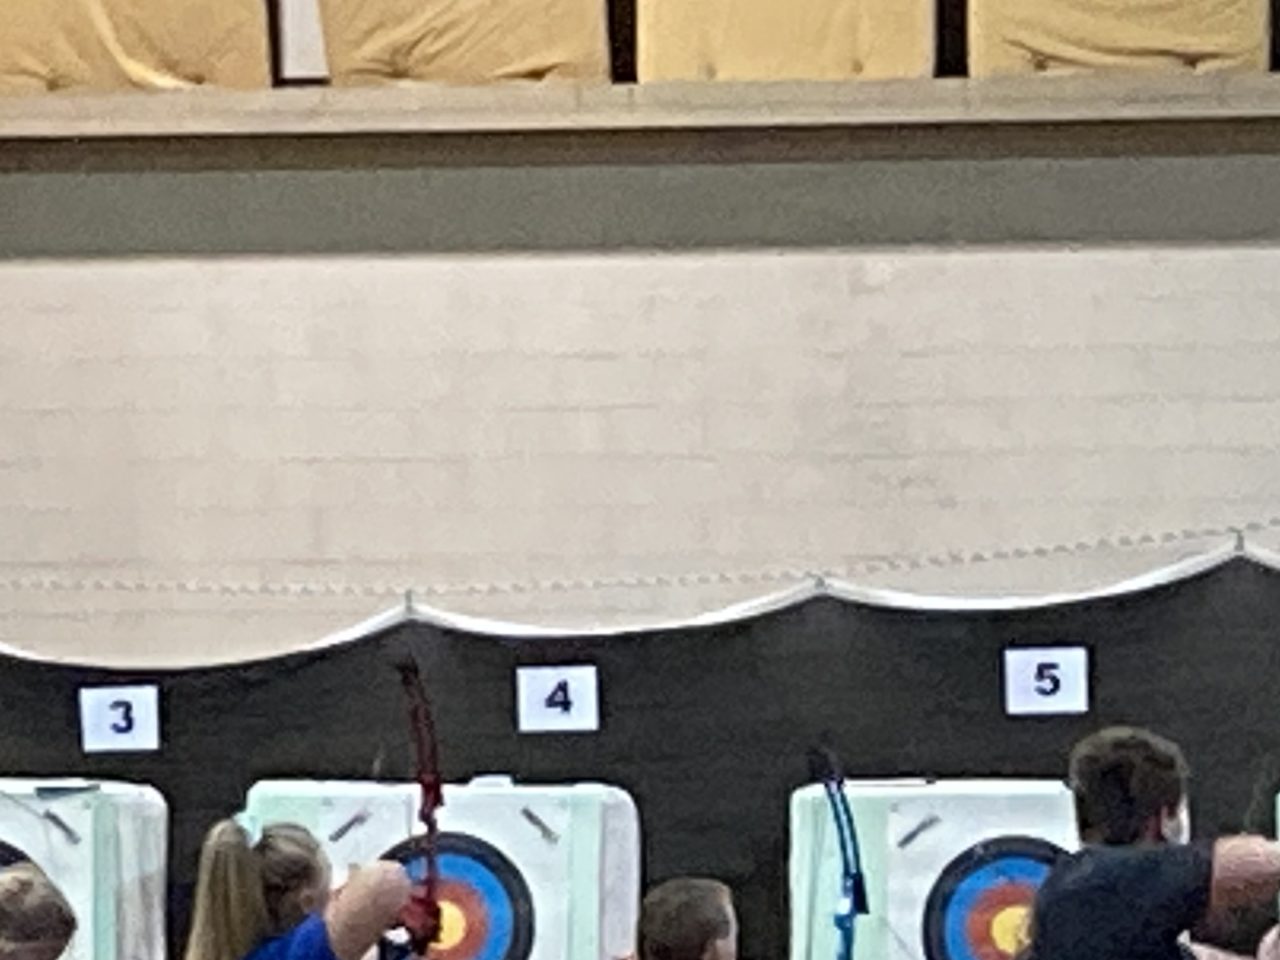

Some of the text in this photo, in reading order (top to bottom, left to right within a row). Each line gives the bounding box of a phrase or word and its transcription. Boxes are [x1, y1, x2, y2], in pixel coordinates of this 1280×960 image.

[544, 680, 573, 713] 4
[1034, 662, 1061, 697] 5
[109, 700, 134, 734] 3
